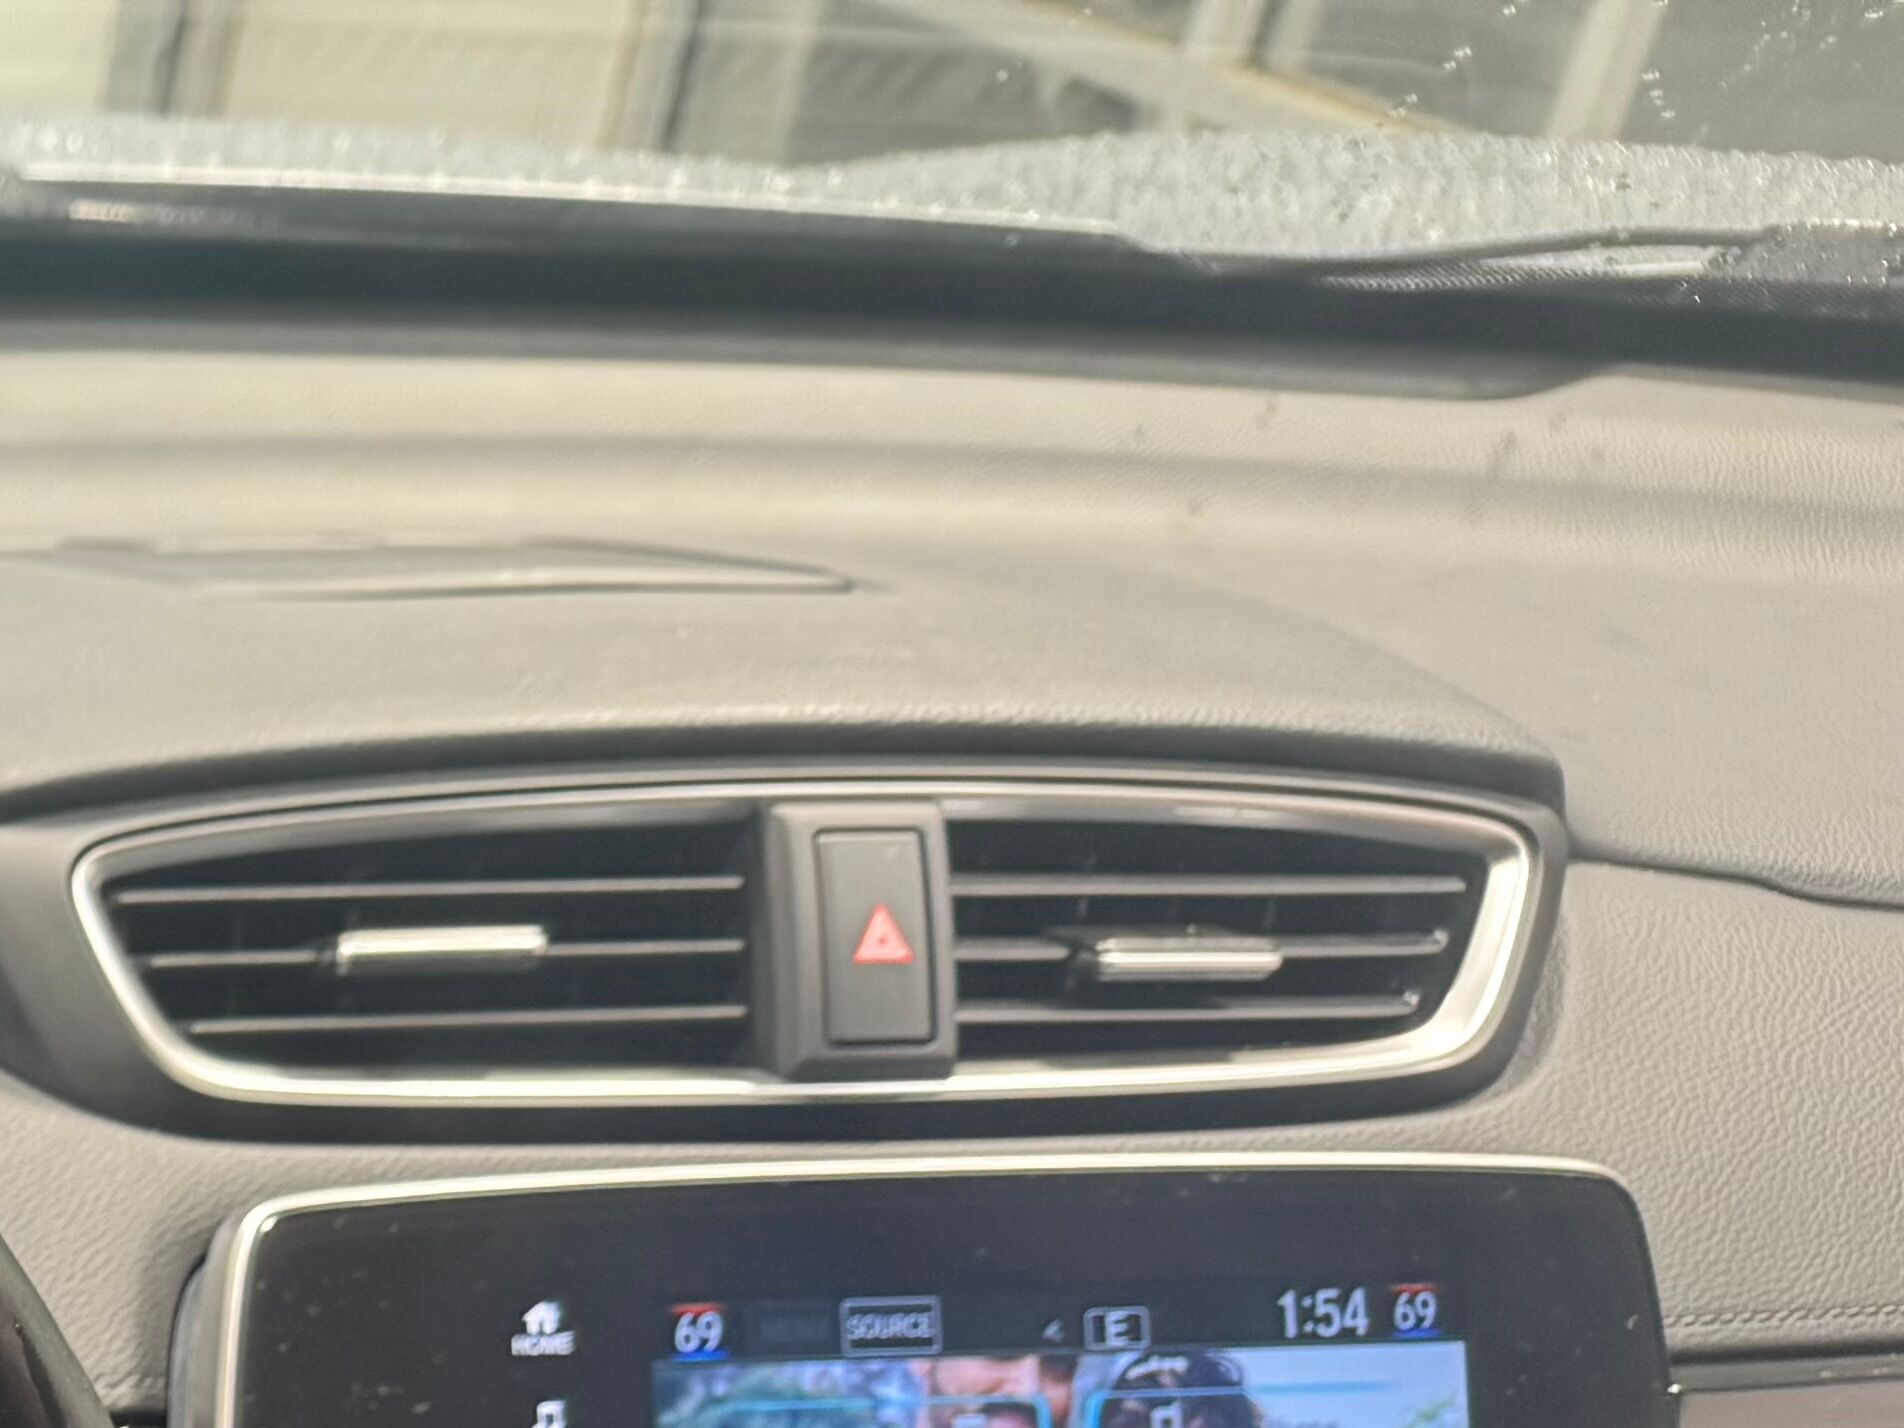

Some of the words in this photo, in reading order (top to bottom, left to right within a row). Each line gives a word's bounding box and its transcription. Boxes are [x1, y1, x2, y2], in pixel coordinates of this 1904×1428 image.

[1277, 1286, 1369, 1339] 1:54
[1393, 1290, 1438, 1331] 69
[673, 1311, 723, 1353] 69
